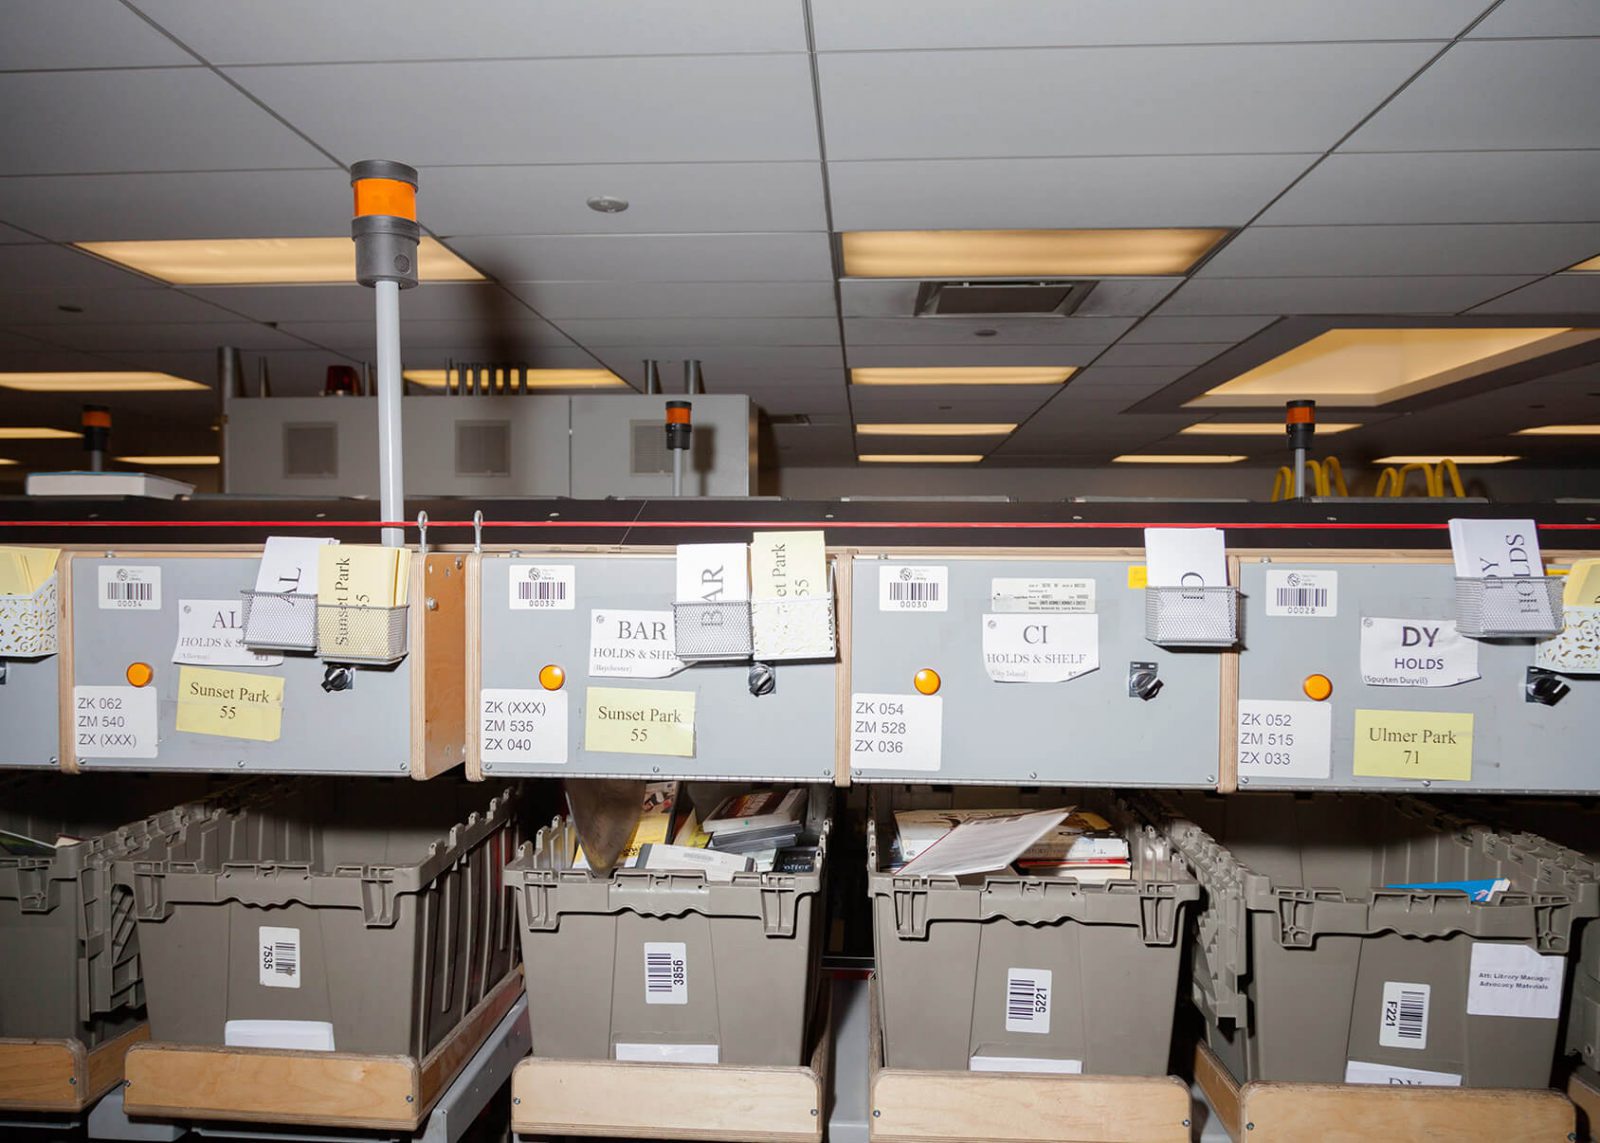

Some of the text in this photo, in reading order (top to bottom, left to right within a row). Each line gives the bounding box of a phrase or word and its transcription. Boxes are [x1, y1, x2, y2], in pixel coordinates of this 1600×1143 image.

[771, 543, 787, 578] Park
[1506, 534, 1539, 613] HOLDS
[279, 567, 302, 607] AL
[794, 579, 810, 597] 55
[335, 558, 351, 646] Sunset Park
[700, 565, 724, 626] BAR
[212, 611, 243, 629] AL
[617, 620, 667, 640] BAR
[1023, 624, 1048, 644] CI
[1401, 626, 1439, 648] DY
[181, 637, 222, 648] HOLDS
[224, 639, 232, 648] &
[593, 648, 636, 659] HOLDS
[638, 650, 646, 659] &
[987, 653, 1087, 665] HOLDS & SHELF
[1394, 658, 1444, 670] HOLDS
[190, 682, 270, 704] Sunset Park
[78, 698, 122, 710] ZK 062
[484, 701, 546, 716] ZK (XXX)
[855, 702, 904, 715] ZK 054
[219, 705, 237, 719] 55
[598, 706, 682, 723] Sunset Park
[78, 716, 125, 728] ZM 540
[484, 720, 534, 732] ZM 535
[855, 721, 906, 734] ZM 528
[1241, 713, 1292, 727] ZK 052
[78, 734, 137, 747] ZX (XXX)
[630, 729, 648, 742] 55
[1240, 733, 1294, 746] ZM 515
[1369, 727, 1457, 745] Ulmer Park
[484, 738, 532, 751] ZX 040
[854, 740, 903, 753] ZX 036
[1240, 752, 1291, 765] ZX 033
[1403, 750, 1420, 765] 71
[263, 945, 273, 969] 7535
[673, 960, 684, 985] 3856
[1035, 988, 1047, 1013] 5221
[1385, 1001, 1398, 1027] F221
